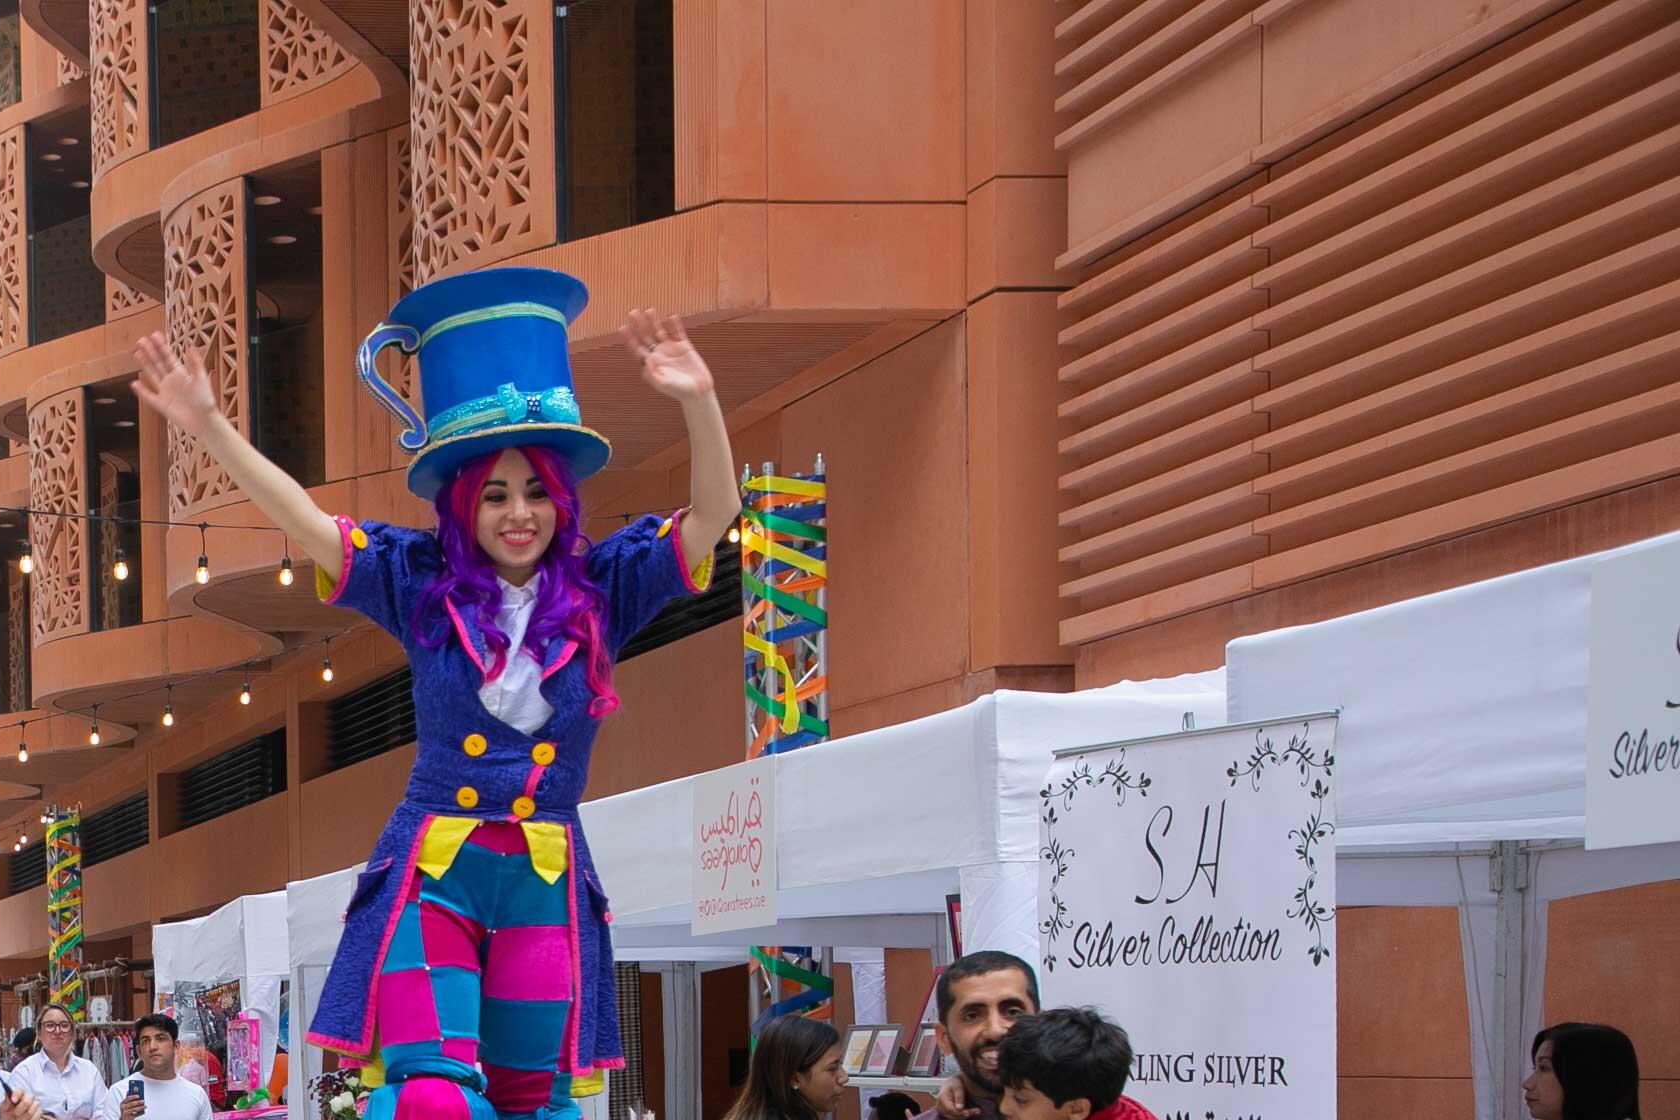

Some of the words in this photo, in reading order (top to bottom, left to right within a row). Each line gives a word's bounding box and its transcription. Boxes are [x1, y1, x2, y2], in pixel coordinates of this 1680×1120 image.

[1067, 920, 1152, 969] Silver
[1158, 914, 1283, 965] Collection
[1129, 1051, 1197, 1086] LING
[1203, 1052, 1289, 1088] SILVER
